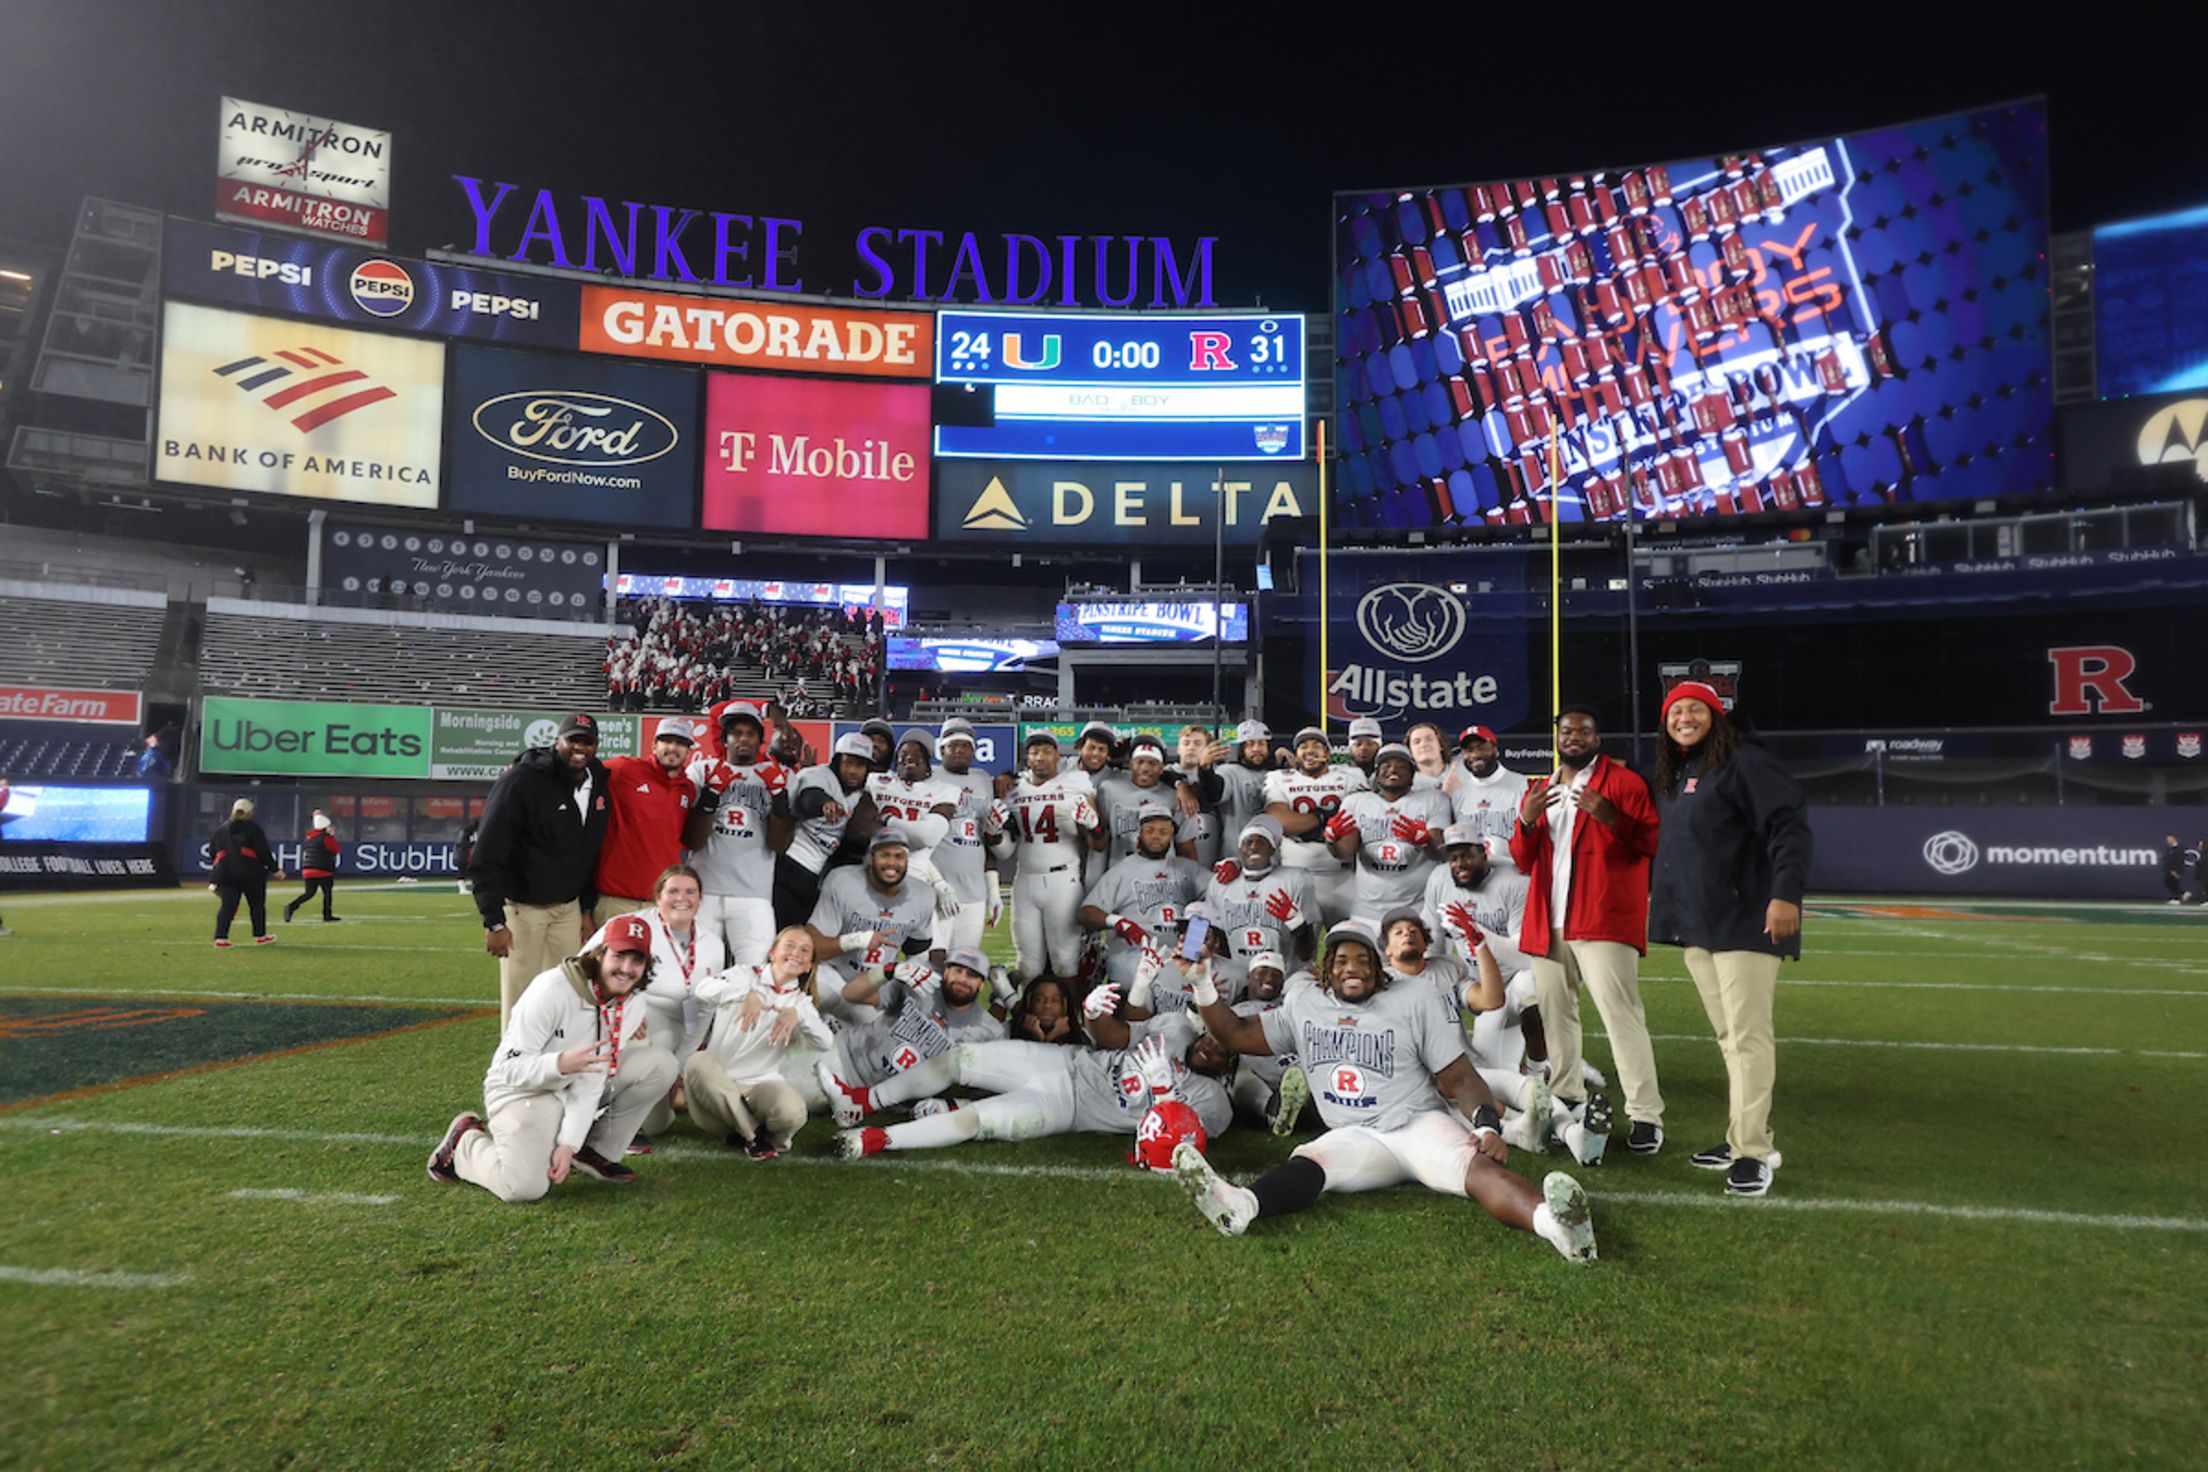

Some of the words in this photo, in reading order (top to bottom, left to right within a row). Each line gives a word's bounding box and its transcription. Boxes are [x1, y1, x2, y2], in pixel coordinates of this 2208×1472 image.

[228, 112, 383, 159] ARMITRON
[233, 187, 371, 226] ARMITRON
[302, 215, 369, 236] WATCHES
[451, 175, 803, 292] YANKEE
[853, 226, 1220, 307] STADIUM
[211, 250, 313, 286] PEPSI
[354, 277, 410, 299] PEPSI
[451, 290, 539, 320] PEPSI
[603, 300, 916, 365] GATORADE
[950, 330, 991, 360] 24
[1002, 332, 1062, 370] U
[1093, 340, 1160, 369] 0:00
[1189, 330, 1234, 371] R
[1250, 334, 1284, 362] 31
[1131, 394, 1170, 406] BOY
[509, 398, 645, 456] Ford
[164, 440, 248, 465] BANK
[259, 450, 296, 470] OF
[303, 457, 432, 486] AMERICA
[719, 431, 756, 472] T
[768, 434, 916, 482] Mobile
[508, 465, 641, 490] BuyFordNow.com
[1052, 481, 1303, 526] DELTA
[411, 557, 440, 572] New
[442, 560, 472, 579] York
[474, 563, 525, 582] Yankees
[1156, 603, 1205, 626] BOWL
[1329, 664, 1498, 710] Allstate
[2048, 645, 2144, 715] R
[440, 712, 521, 733] Morningside
[597, 718, 632, 733] men's
[213, 718, 315, 755] Uber
[325, 724, 422, 758] Eats
[1889, 738, 1944, 751] roadway
[1505, 748, 1554, 759] BuyFordNo
[728, 811, 744, 826] R
[1020, 804, 1059, 843] 14
[44, 856, 95, 874] FOOTBALL
[95, 859, 126, 874] LIVES
[126, 859, 156, 875] HERE
[355, 844, 460, 871] StubHu
[1382, 846, 1397, 861] R
[1987, 844, 2158, 866] momentum
[1162, 908, 1174, 922] R
[628, 923, 644, 939] R
[1247, 931, 1264, 946] R
[865, 950, 881, 963] R
[897, 1048, 917, 1070] R
[1304, 1020, 1394, 1079] CHAMPIONS
[1122, 1074, 1142, 1095] R
[1338, 1070, 1359, 1092] R
